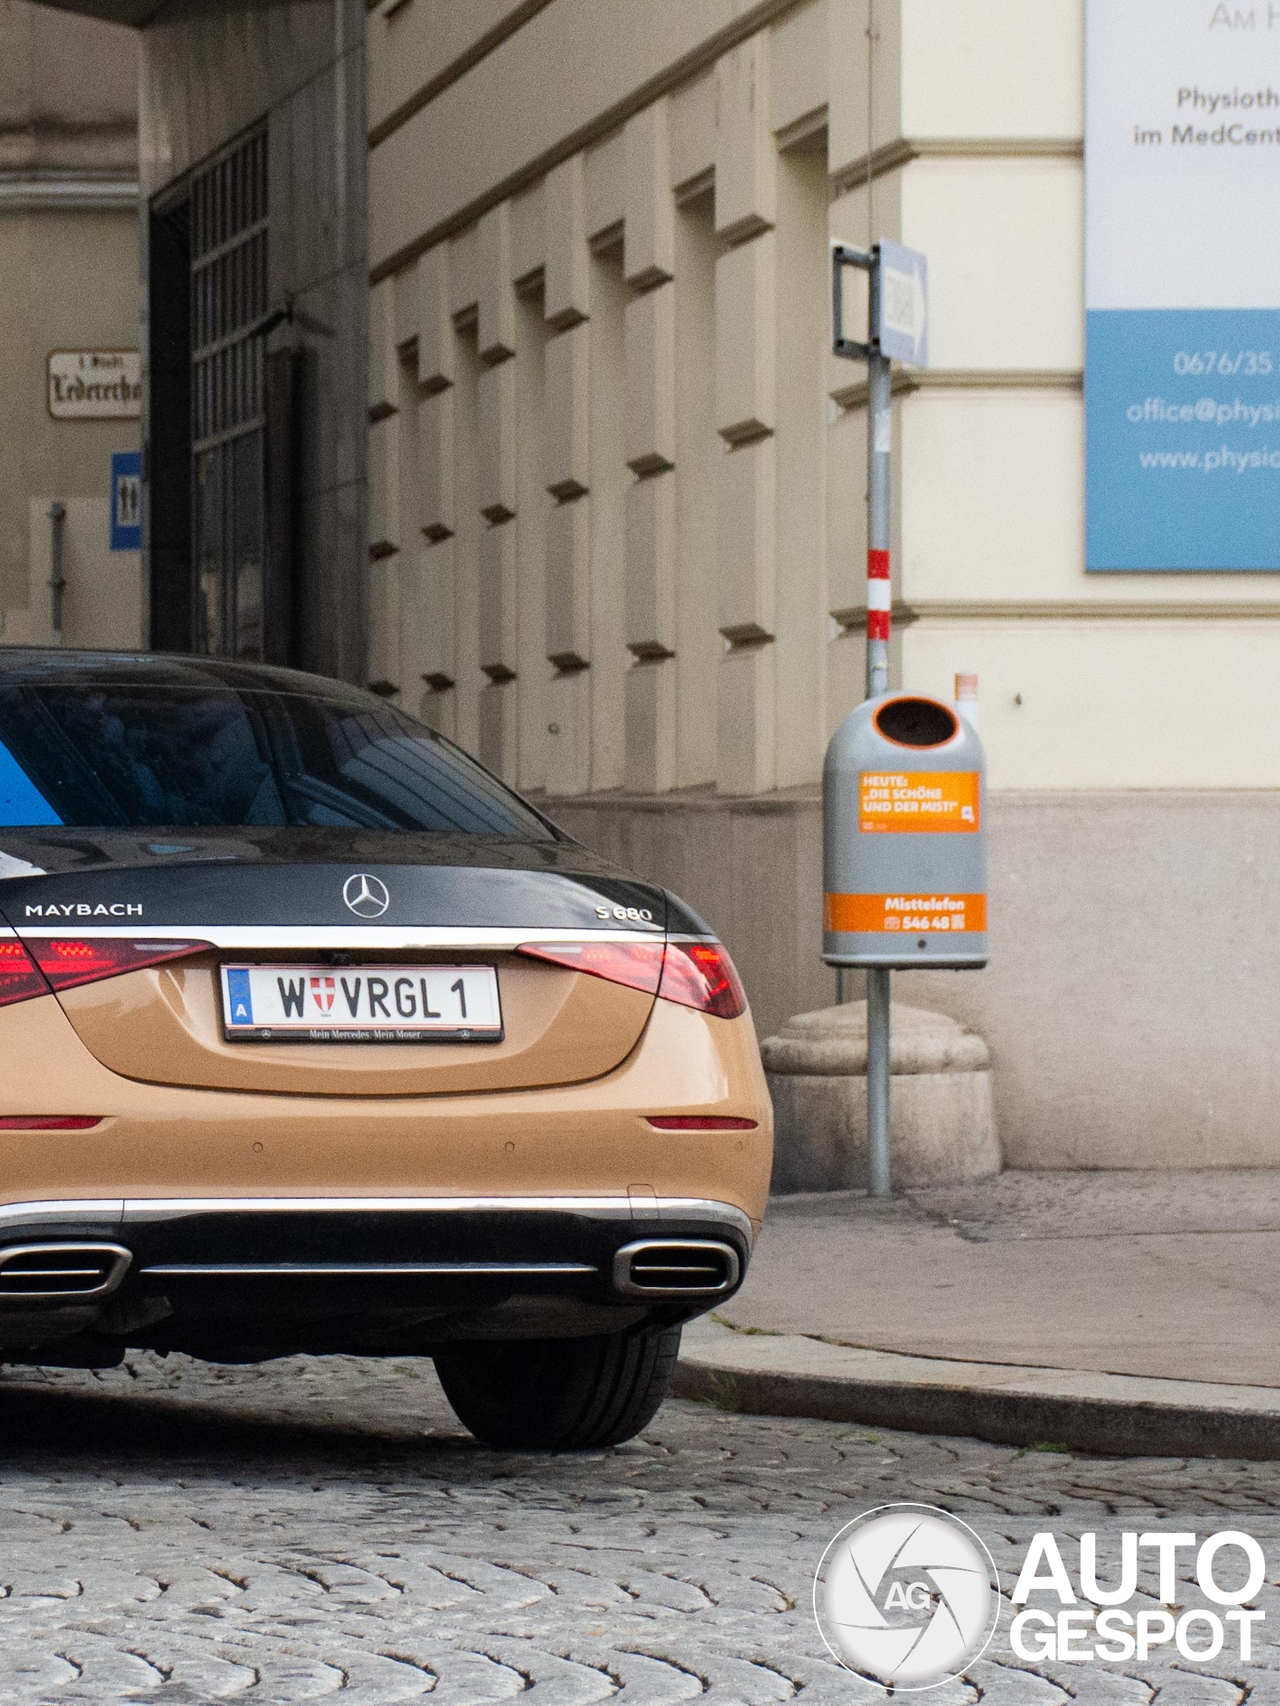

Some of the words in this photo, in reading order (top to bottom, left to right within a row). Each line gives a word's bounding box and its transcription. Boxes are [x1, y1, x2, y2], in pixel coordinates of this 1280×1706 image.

[1134, 124, 1162, 145] im
[1173, 351, 1273, 376] 0676/35
[862, 776, 908, 787] HEUTE:
[892, 786, 942, 800] SCHÖNE
[863, 801, 892, 813] UND
[894, 801, 919, 813] DER
[25, 904, 143, 917] MAYBACH
[885, 896, 965, 911] Misttelefon
[595, 906, 610, 919] S
[612, 907, 653, 921] 680
[902, 915, 930, 930] 546
[931, 915, 950, 930] 48
[277, 977, 305, 1018] W
[340, 977, 441, 1018] VRGL
[451, 978, 467, 1018] 1
[236, 1003, 247, 1017] A
[310, 1029, 330, 1039] Mein
[374, 1029, 394, 1039] Mein
